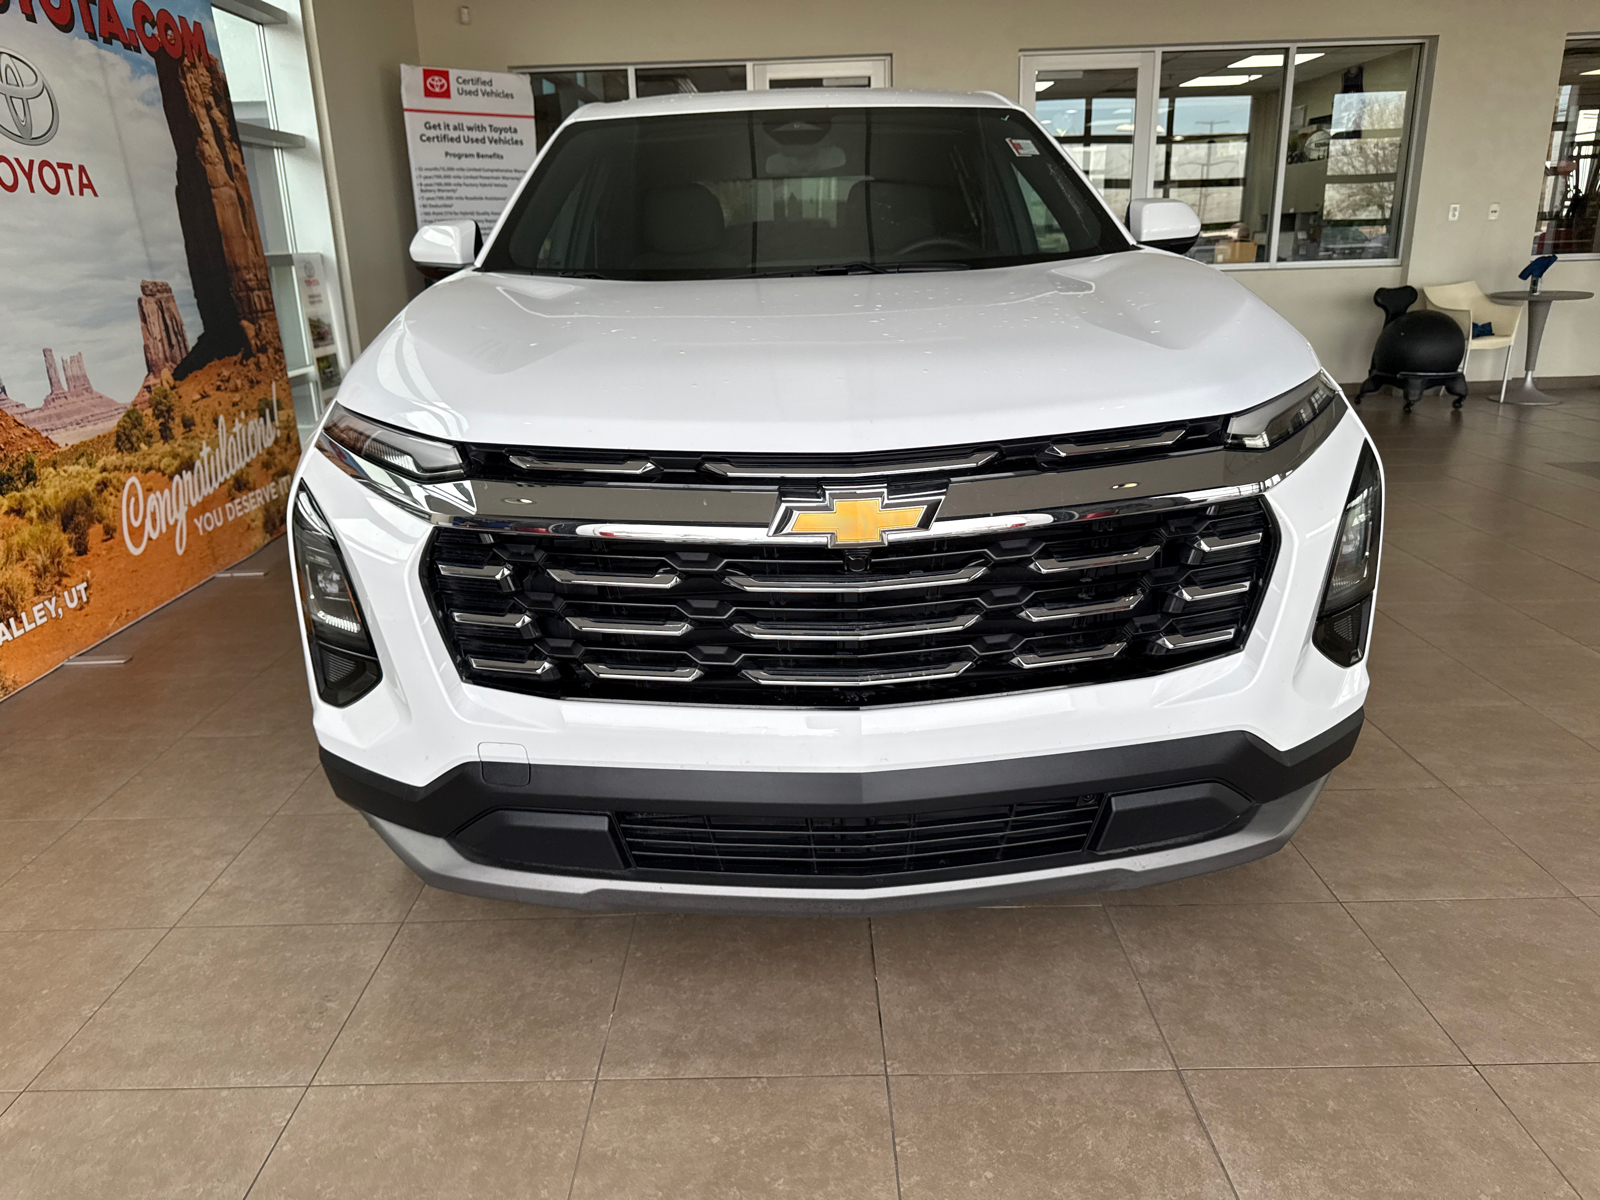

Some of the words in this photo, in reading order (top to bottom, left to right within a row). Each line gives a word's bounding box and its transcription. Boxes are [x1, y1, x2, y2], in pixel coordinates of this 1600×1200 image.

[456, 76, 493, 87] Certified
[457, 88, 479, 97] Used
[480, 89, 514, 100] Vehicles
[424, 121, 443, 131] Get
[443, 122, 451, 131] it
[452, 122, 465, 132] all
[466, 123, 487, 133] with
[488, 124, 518, 135] Toyota
[420, 133, 461, 144] Certified
[463, 135, 486, 145] Used
[487, 136, 524, 147] Vehicles
[445, 151, 475, 160] Program
[476, 152, 504, 160] Benefits
[122, 380, 281, 556] Congratulations!
[194, 506, 224, 536] YOU
[225, 481, 279, 522] DESERVE
[63, 582, 88, 609] UT
